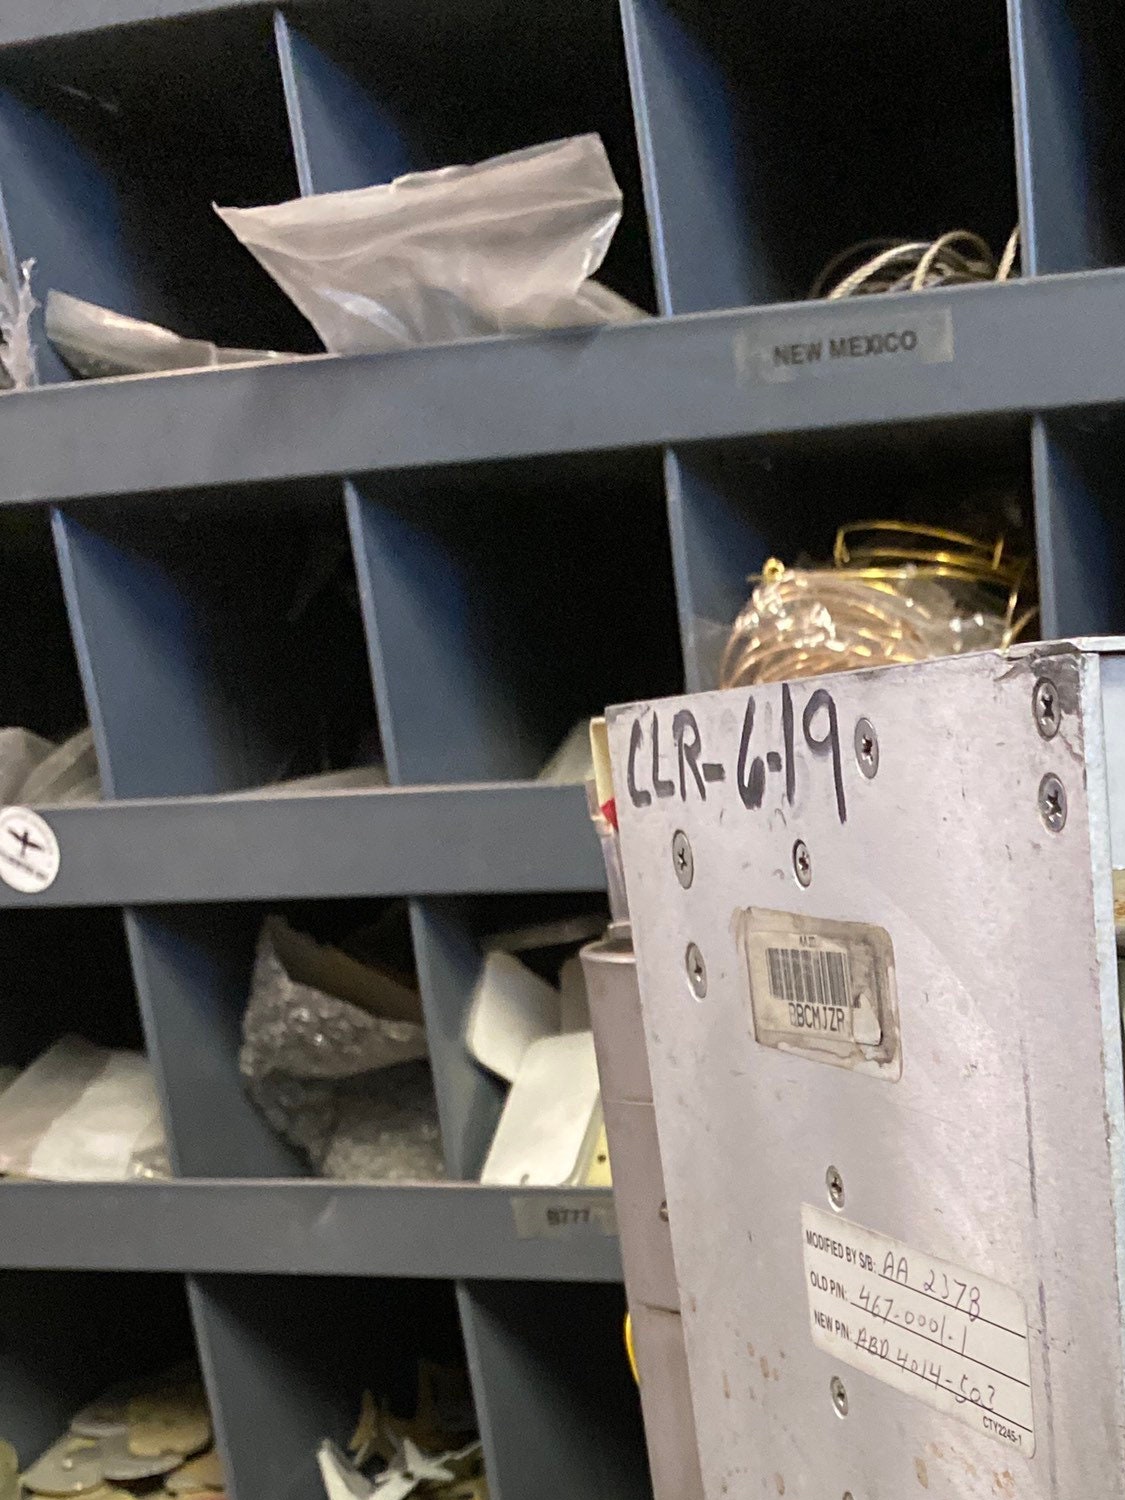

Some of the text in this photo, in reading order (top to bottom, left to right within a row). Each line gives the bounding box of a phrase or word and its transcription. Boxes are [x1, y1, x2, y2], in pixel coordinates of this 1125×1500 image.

[772, 330, 919, 366] NEW MEXICO
[805, 1229, 845, 1260] MODIFIED
[845, 1246, 857, 1265] BY
[810, 1270, 829, 1292] OLD
[882, 1250, 909, 1284] AA
[814, 1309, 834, 1333] NEW
